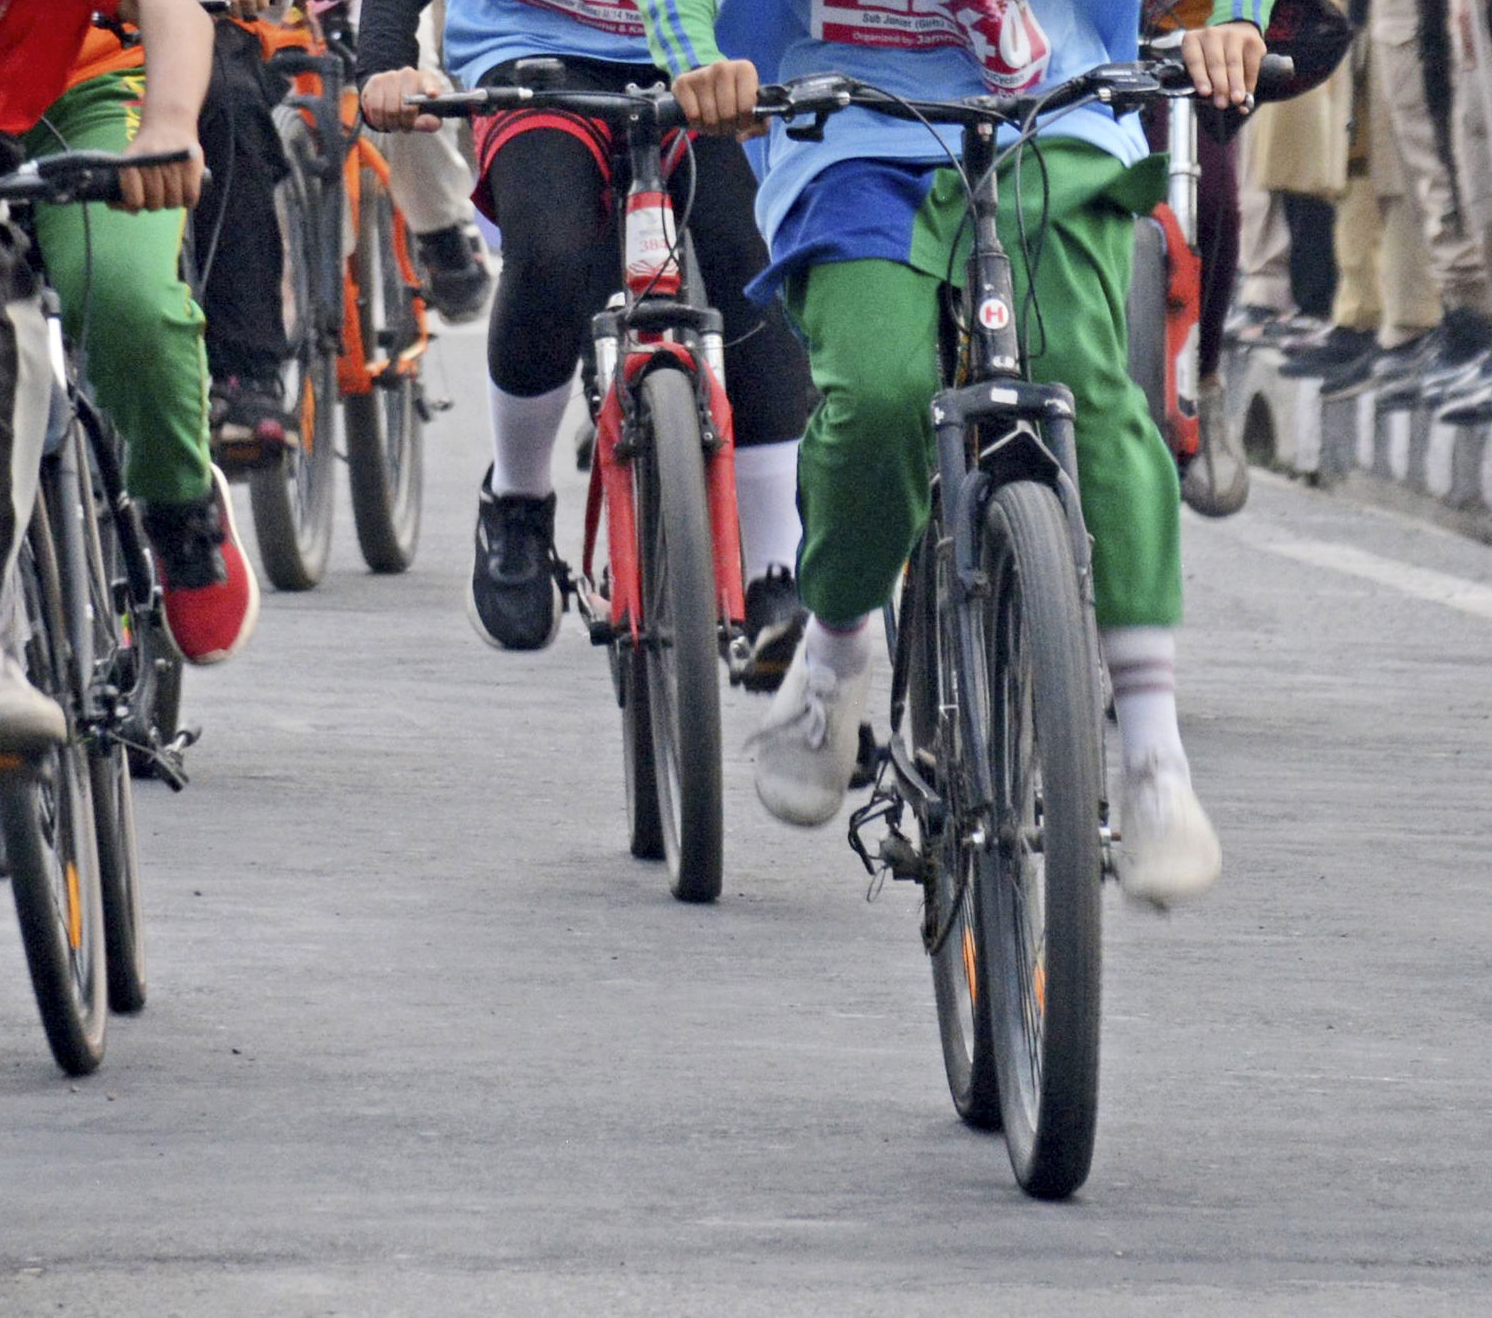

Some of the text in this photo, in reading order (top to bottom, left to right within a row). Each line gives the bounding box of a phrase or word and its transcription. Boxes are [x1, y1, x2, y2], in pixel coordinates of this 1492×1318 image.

[862, 13, 881, 25] Sub
[883, 16, 912, 29] Junior
[985, 306, 1005, 323] H
